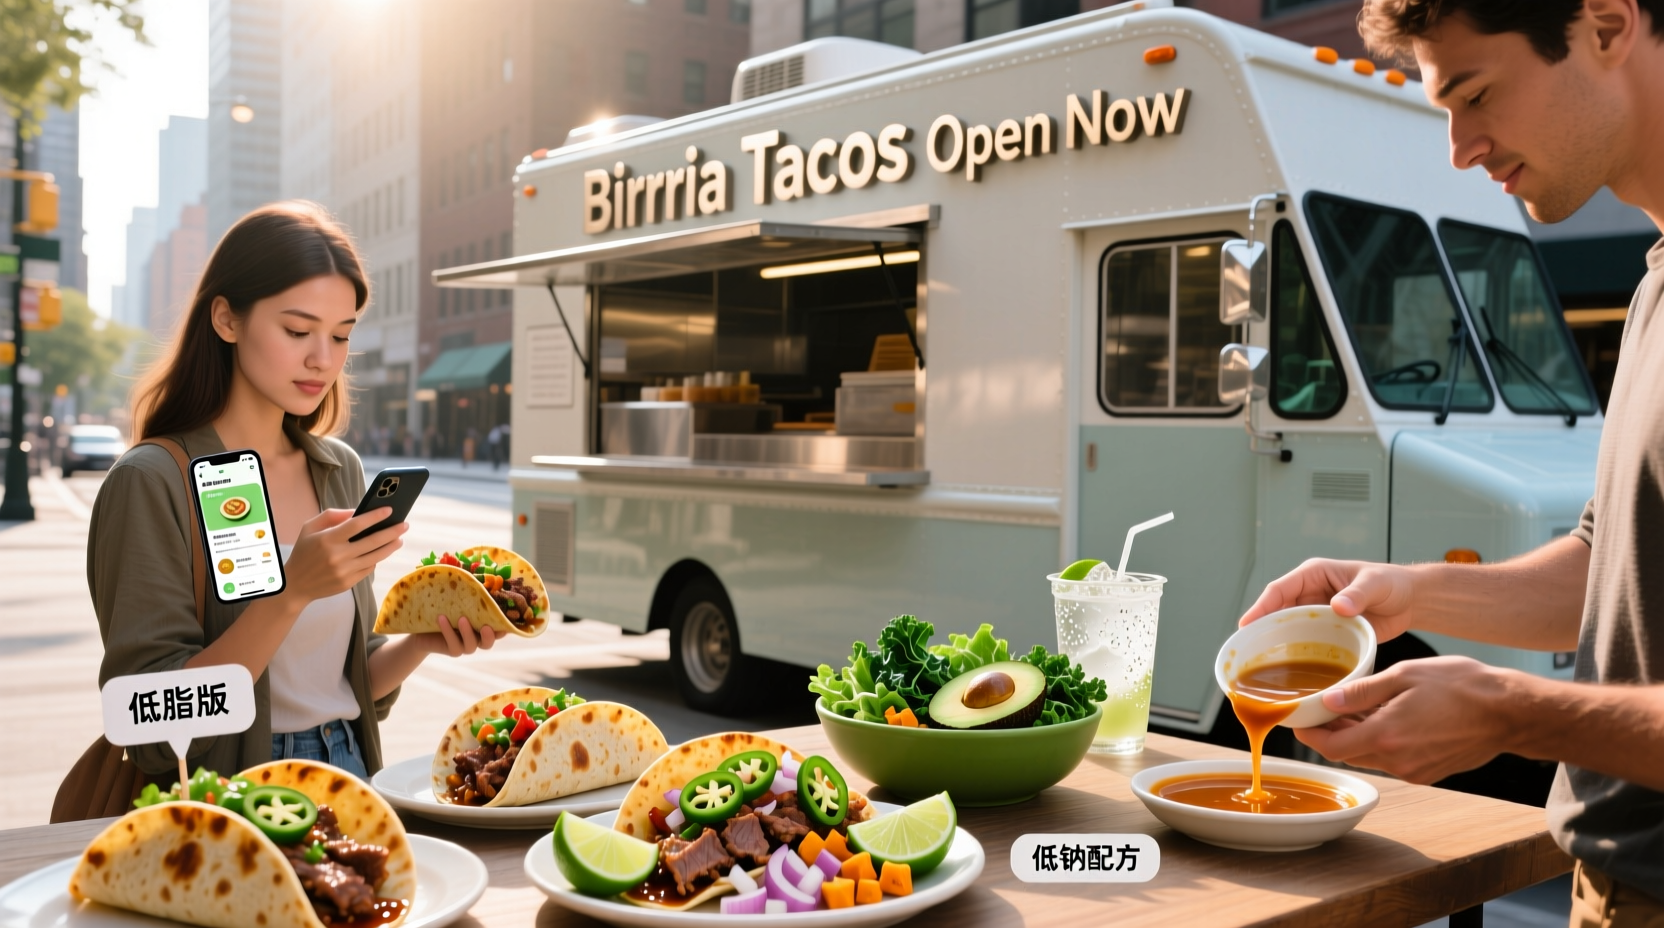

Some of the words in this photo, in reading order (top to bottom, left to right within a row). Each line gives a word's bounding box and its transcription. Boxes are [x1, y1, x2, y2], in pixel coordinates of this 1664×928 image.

[584, 145, 727, 234] Birrria
[741, 123, 909, 205] Tacos
[926, 113, 1051, 182] Open
[1066, 88, 1188, 150] Now
[128, 682, 230, 725] 低脂版
